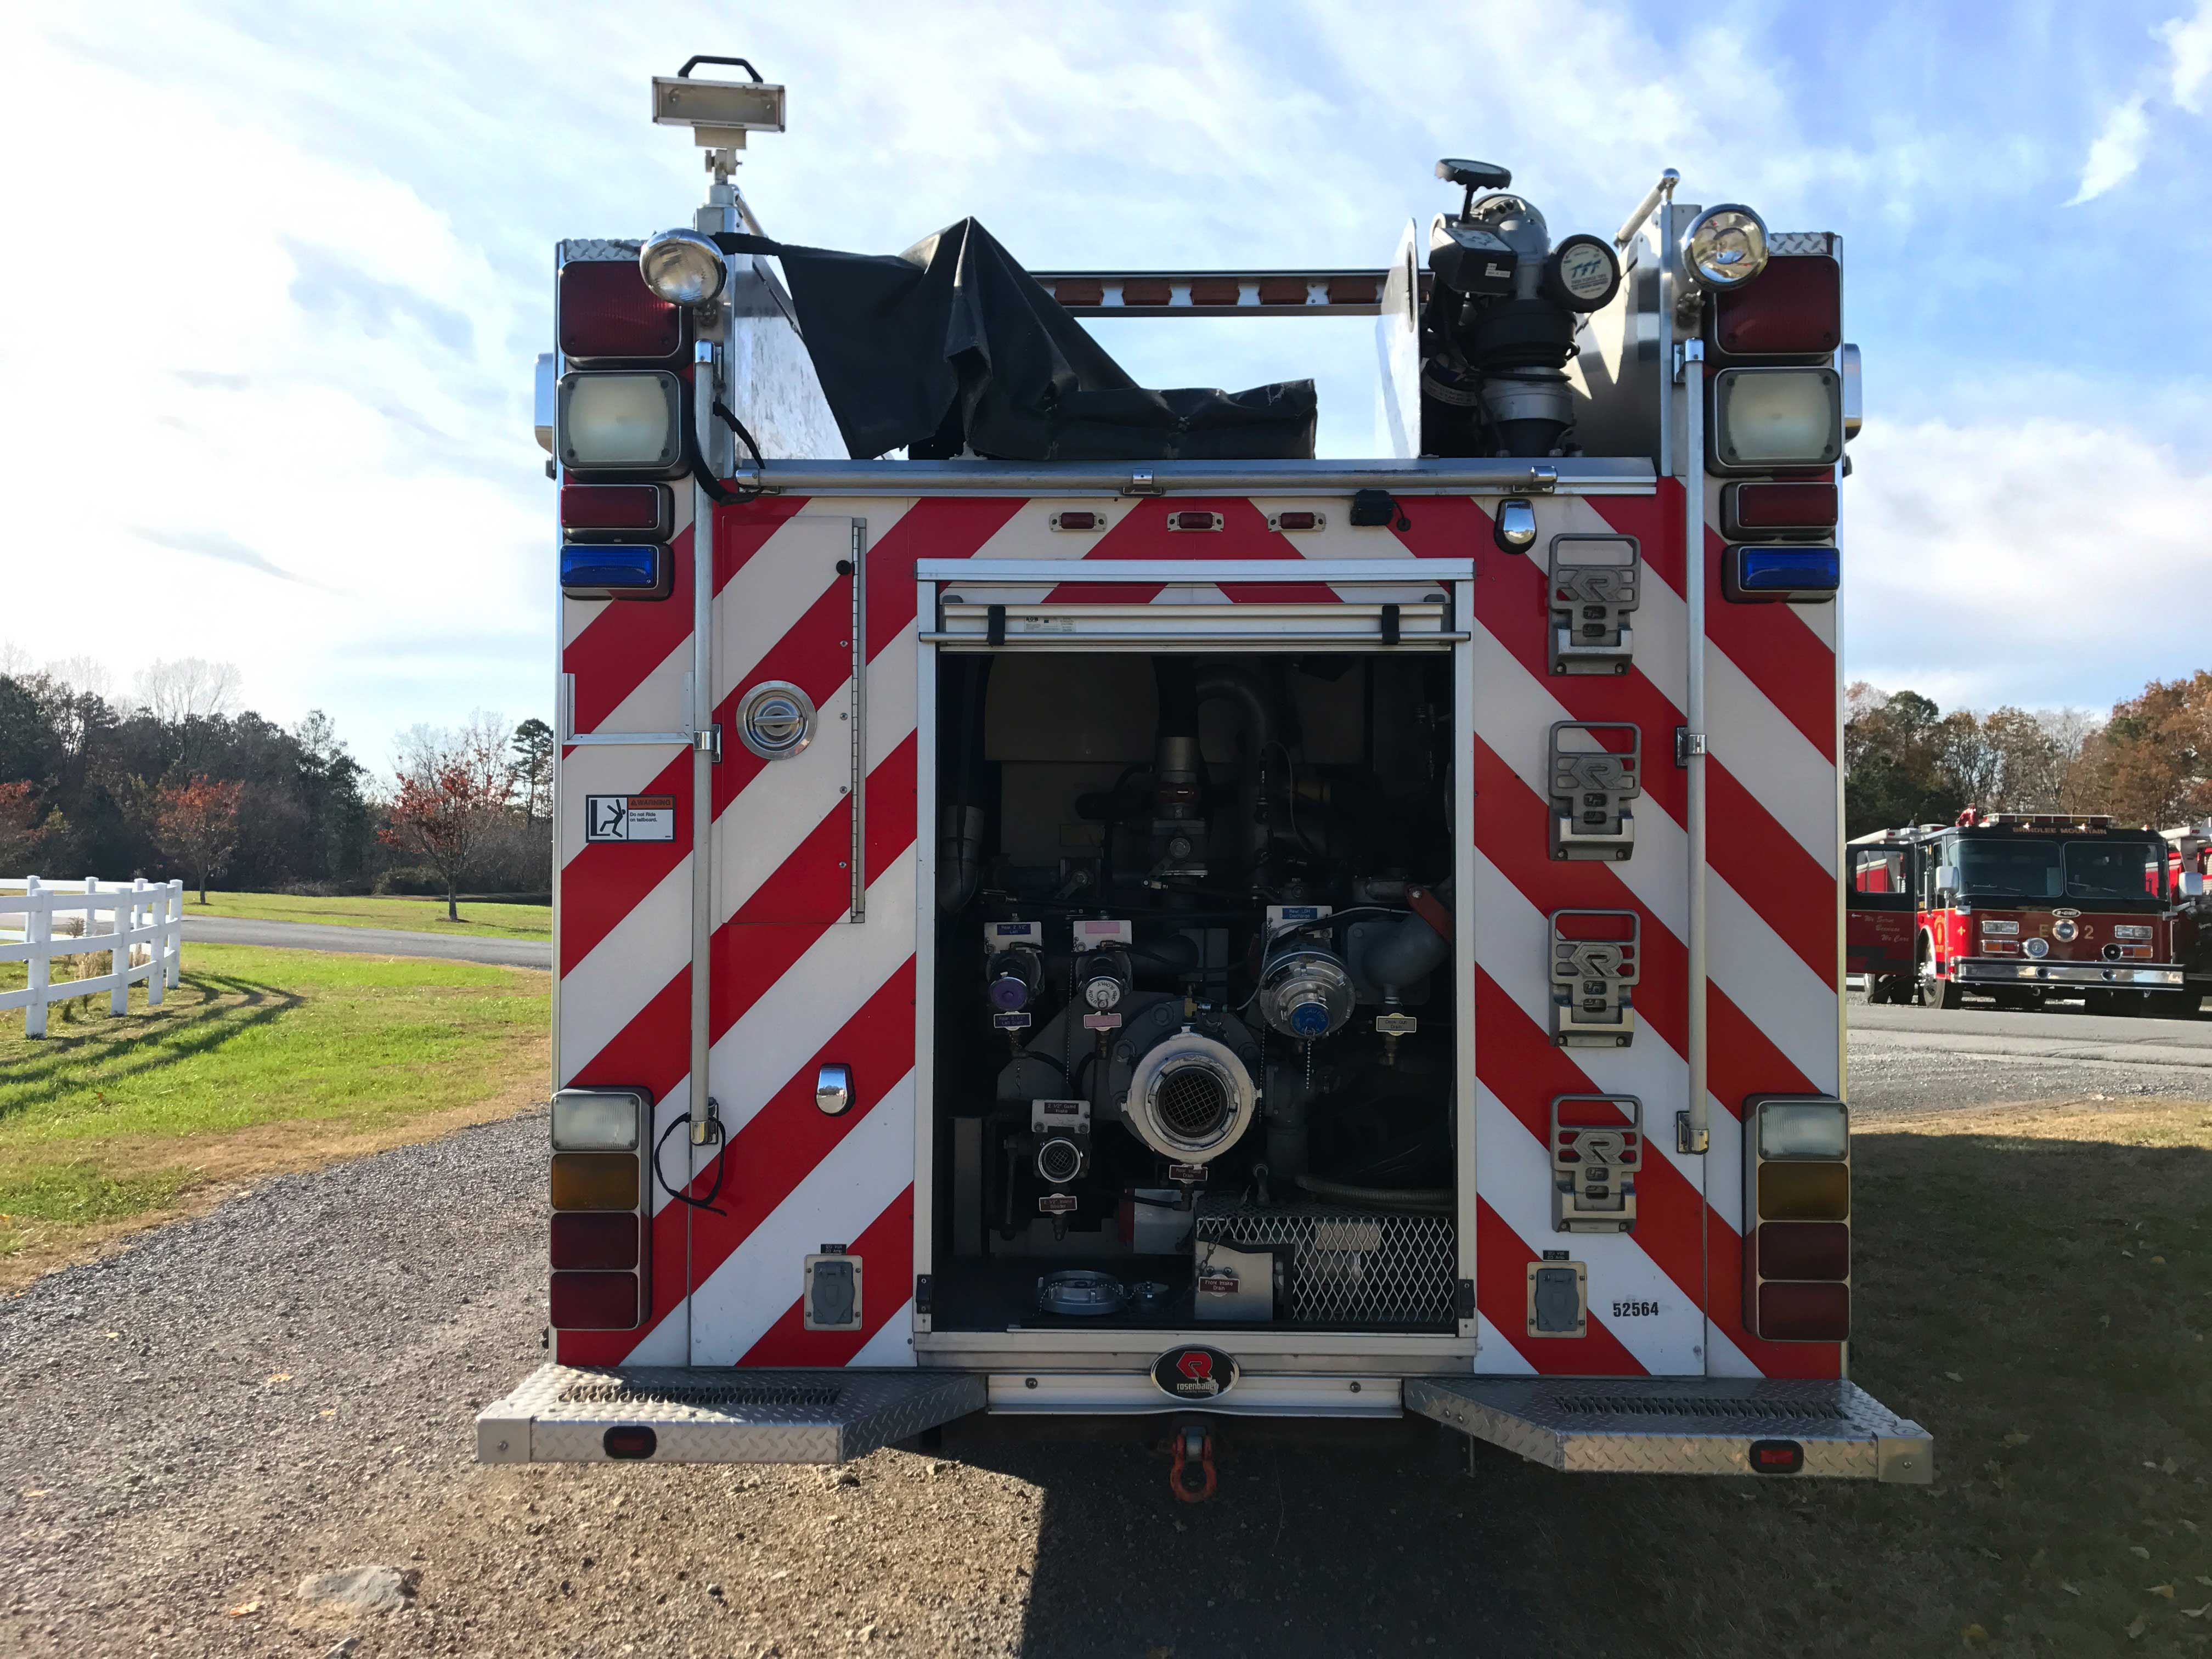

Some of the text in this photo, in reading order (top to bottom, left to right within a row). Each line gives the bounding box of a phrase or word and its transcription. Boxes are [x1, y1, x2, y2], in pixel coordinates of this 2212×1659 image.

[2040, 924, 2094, 939] E 2
[1613, 1301, 1659, 1317] 52564
[1176, 1381, 1217, 1390] rosenbauer
